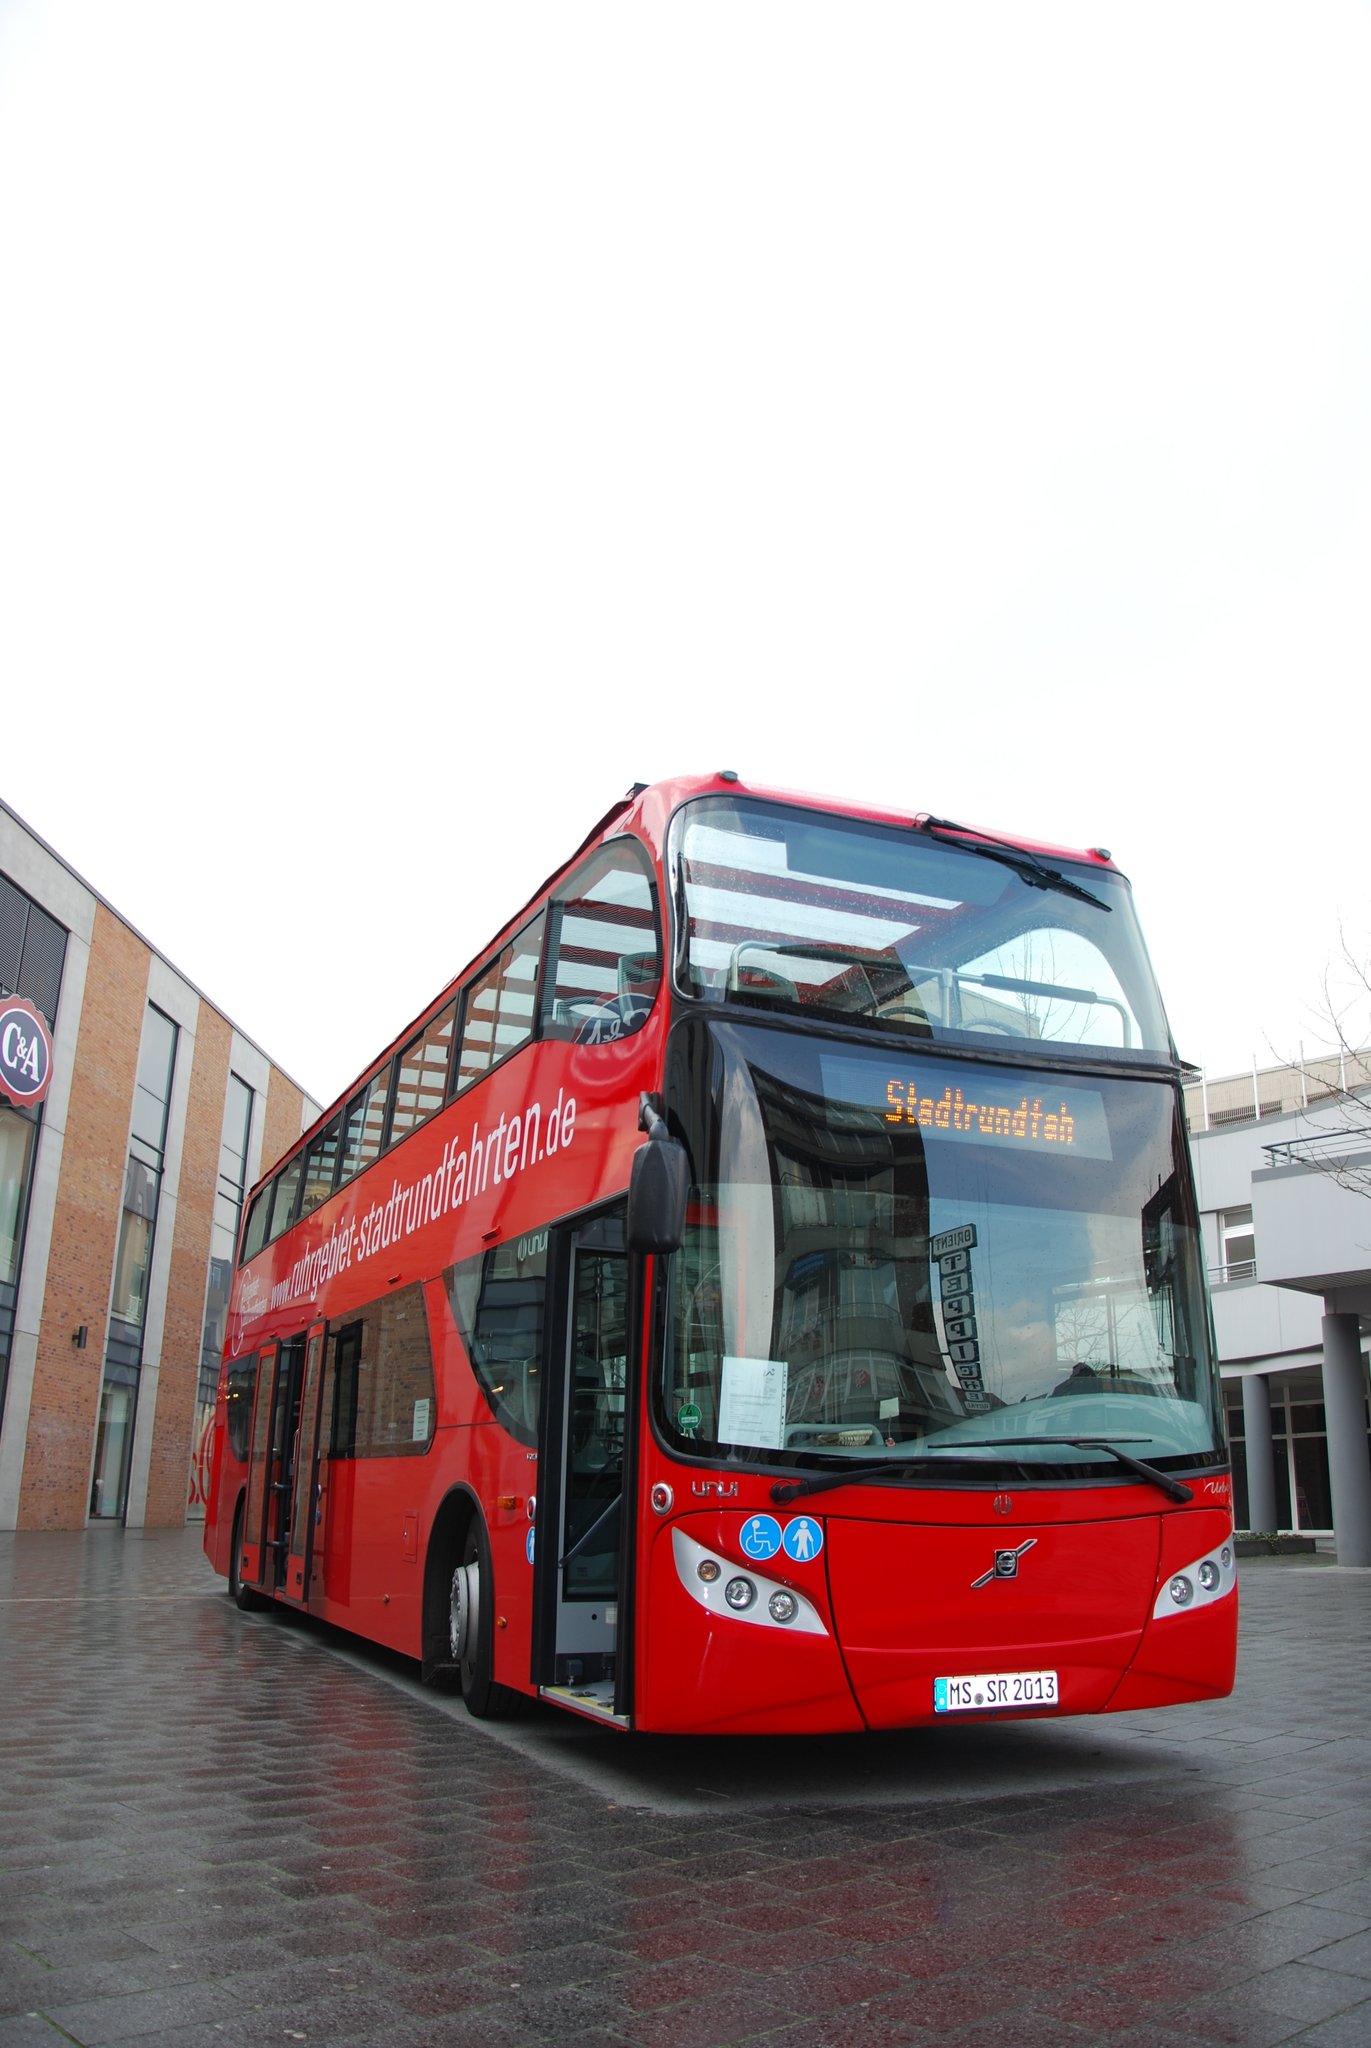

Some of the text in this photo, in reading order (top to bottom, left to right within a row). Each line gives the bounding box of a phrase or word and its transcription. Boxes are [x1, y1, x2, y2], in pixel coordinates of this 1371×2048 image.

[2, 1022, 39, 1082] C&A
[885, 1080, 1074, 1144] Stadtrundfah
[271, 1088, 576, 1310] www.ruhrgebiet-stadtrundfahrten.de
[950, 1677, 1055, 1705] MS SR 2013
